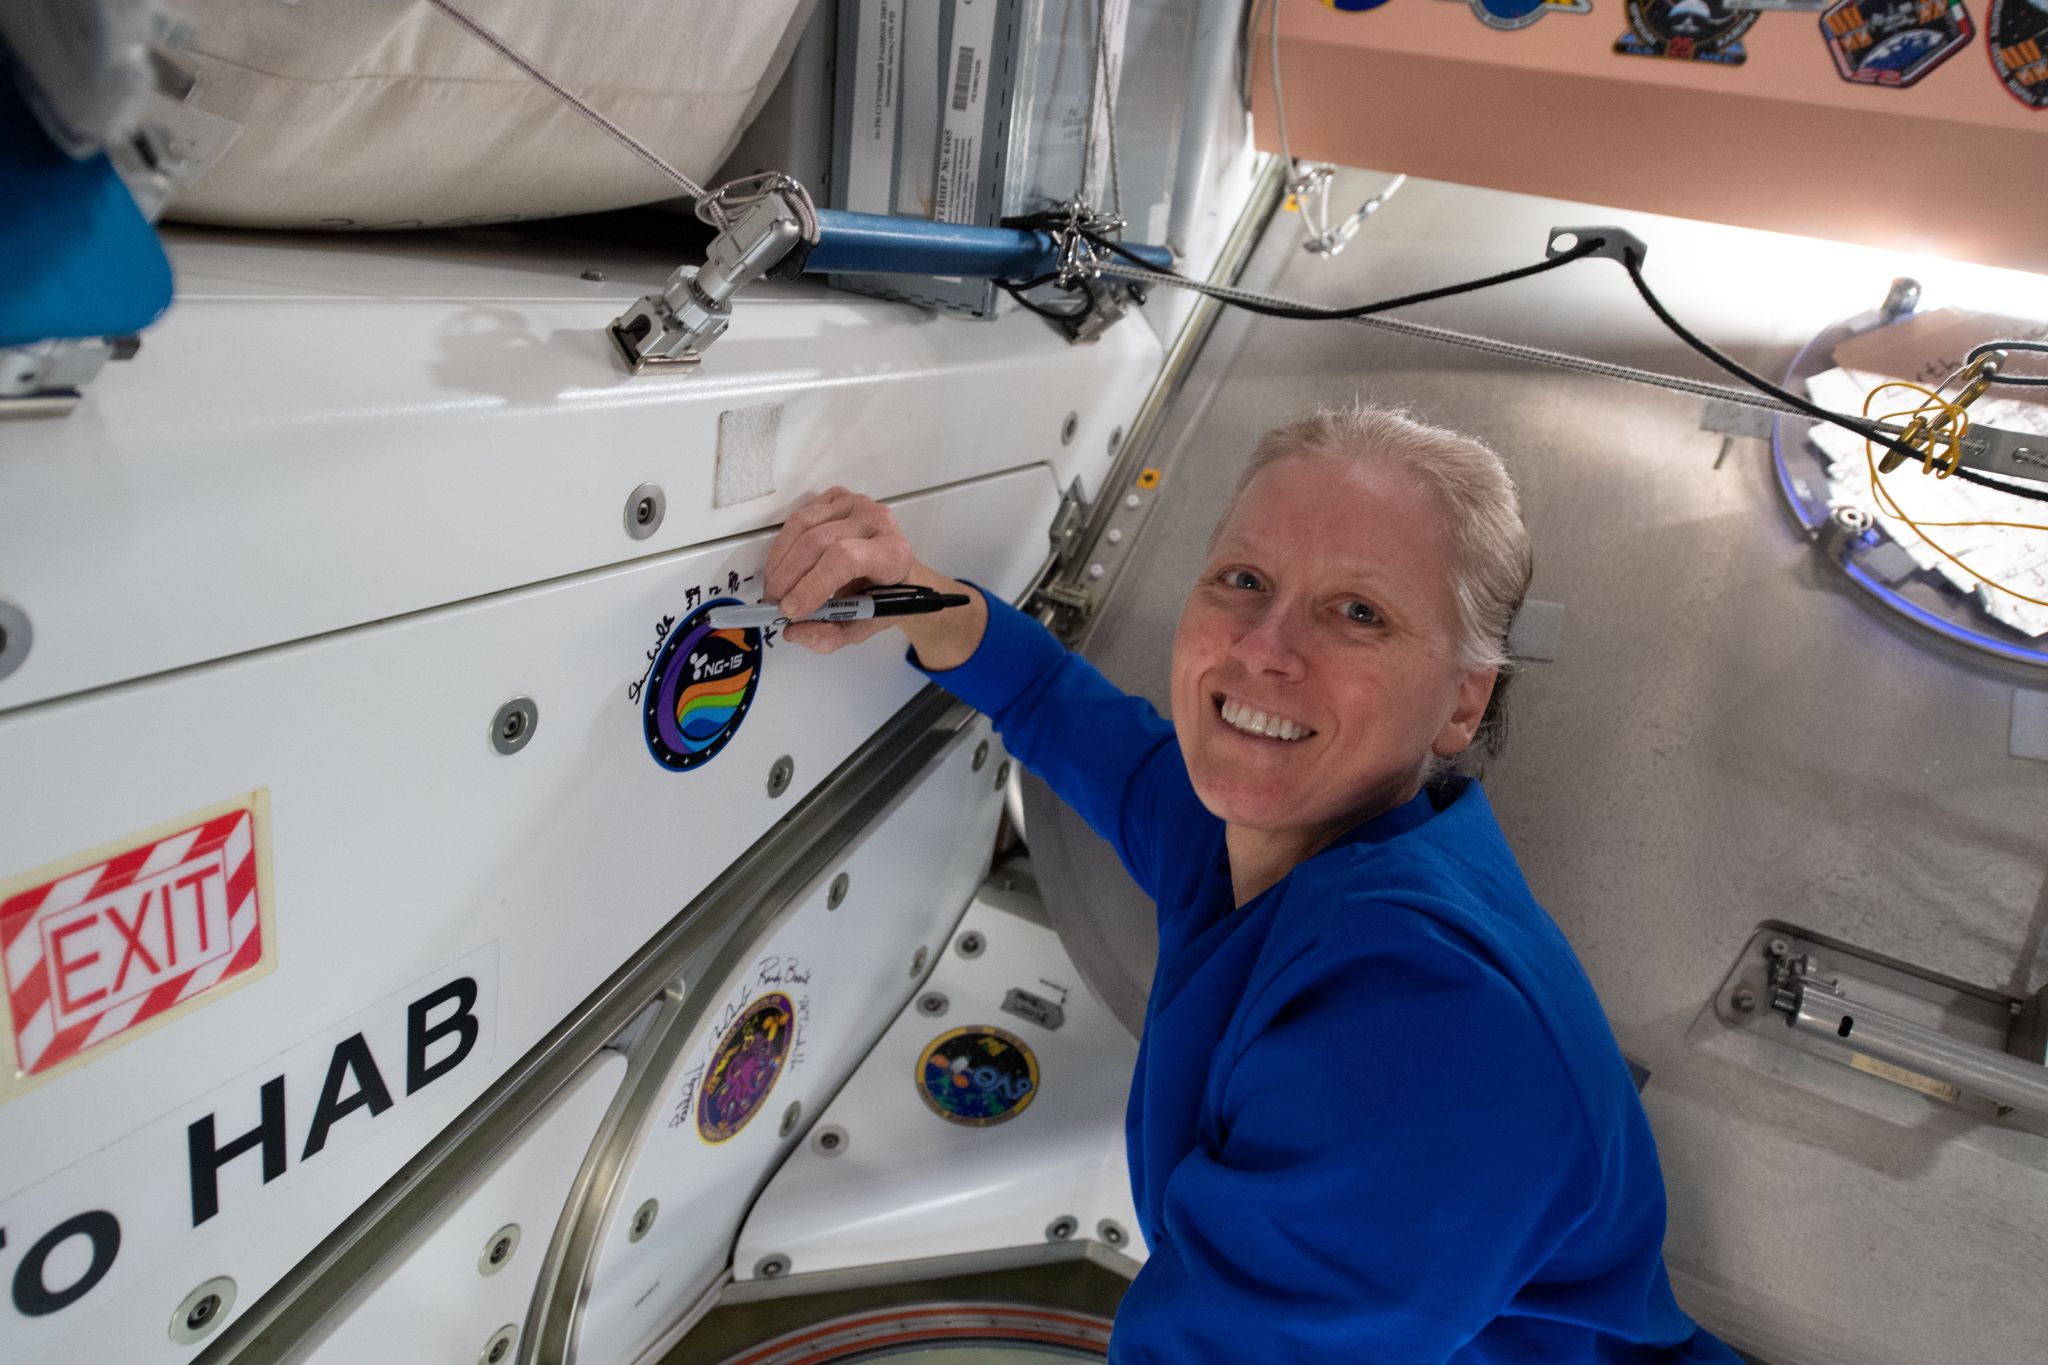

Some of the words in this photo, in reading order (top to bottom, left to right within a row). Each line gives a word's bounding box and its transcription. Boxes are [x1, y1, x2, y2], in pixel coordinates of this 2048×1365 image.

[942, 129, 953, 154] 6165
[704, 653, 744, 678] NG-15
[49, 862, 222, 1016] EXIT
[0, 1210, 121, 1317] O
[188, 976, 479, 1230] HAB
